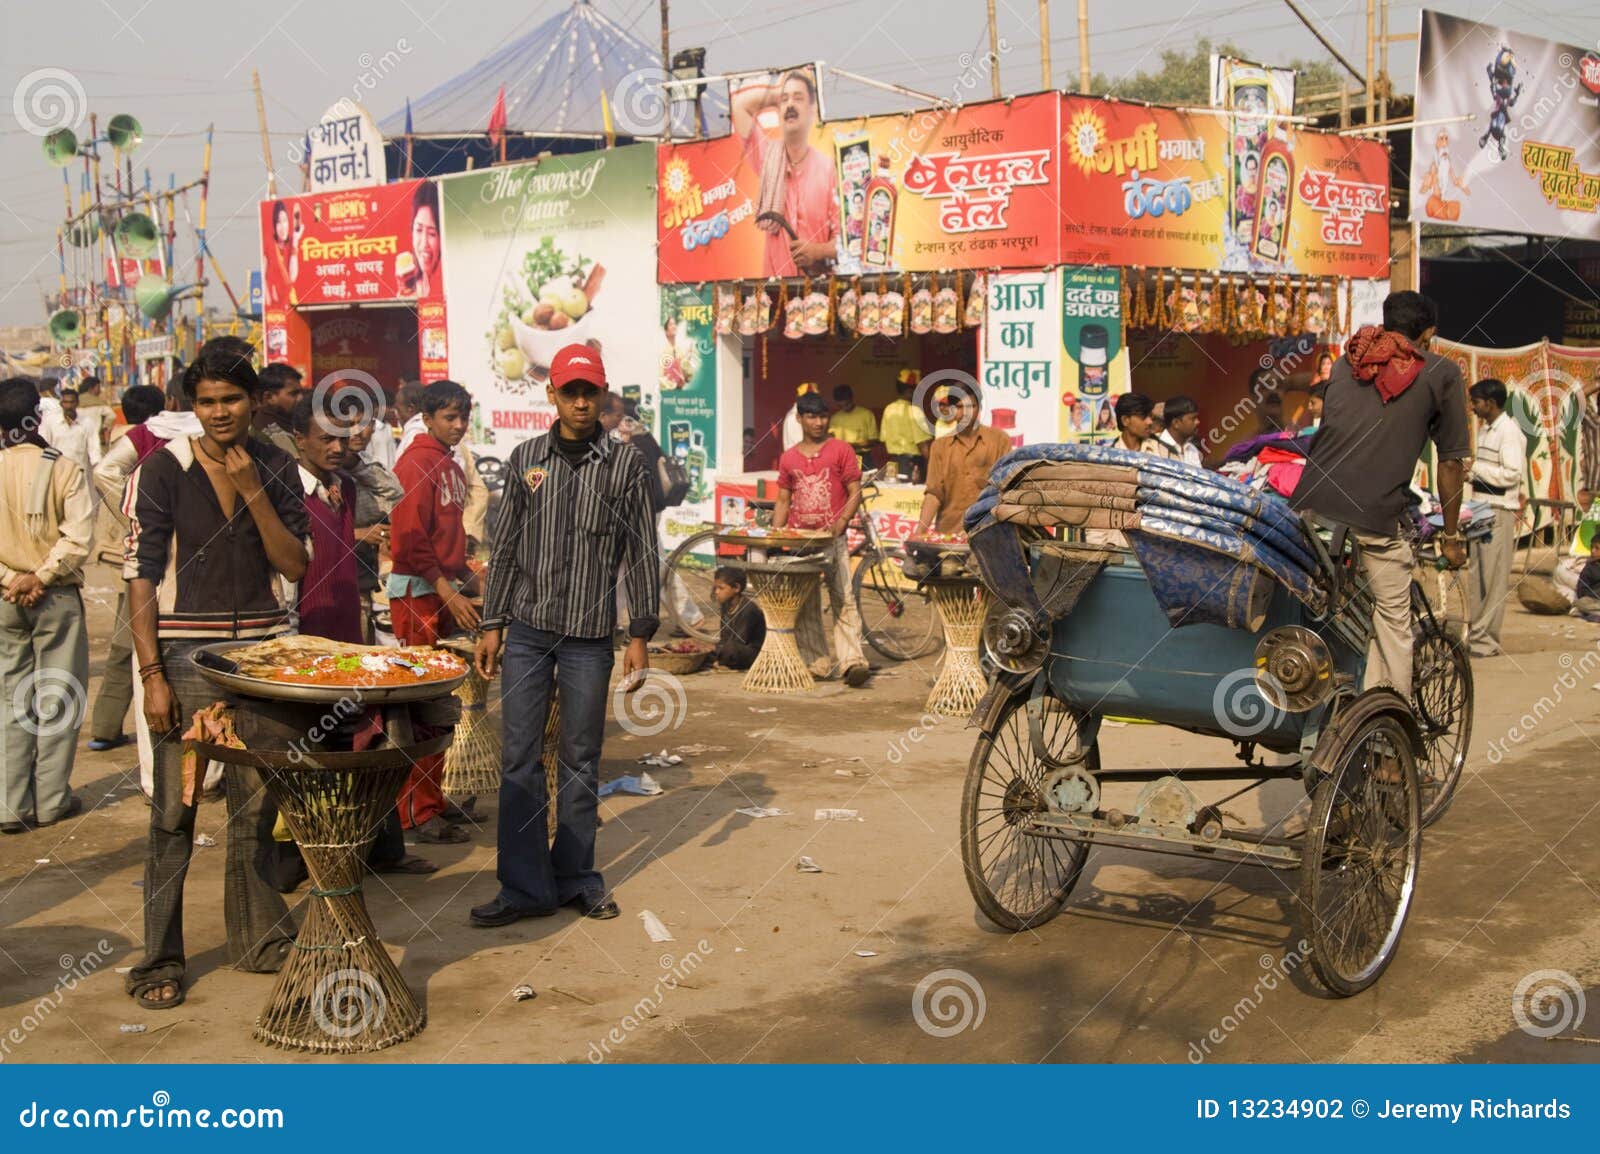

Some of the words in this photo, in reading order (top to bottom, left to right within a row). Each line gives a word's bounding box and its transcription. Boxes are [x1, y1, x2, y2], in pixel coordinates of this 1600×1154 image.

[319, 115, 361, 147] भारत
[942, 128, 1005, 151] आयुर्वेदिक
[480, 166, 523, 204] The
[301, 233, 398, 262] निलॉन्स
[991, 282, 1046, 312] आज
[1066, 284, 1093, 304] दर्द
[1095, 290, 1119, 304] का
[1000, 321, 1035, 349] का
[985, 360, 1052, 399] दातुन
